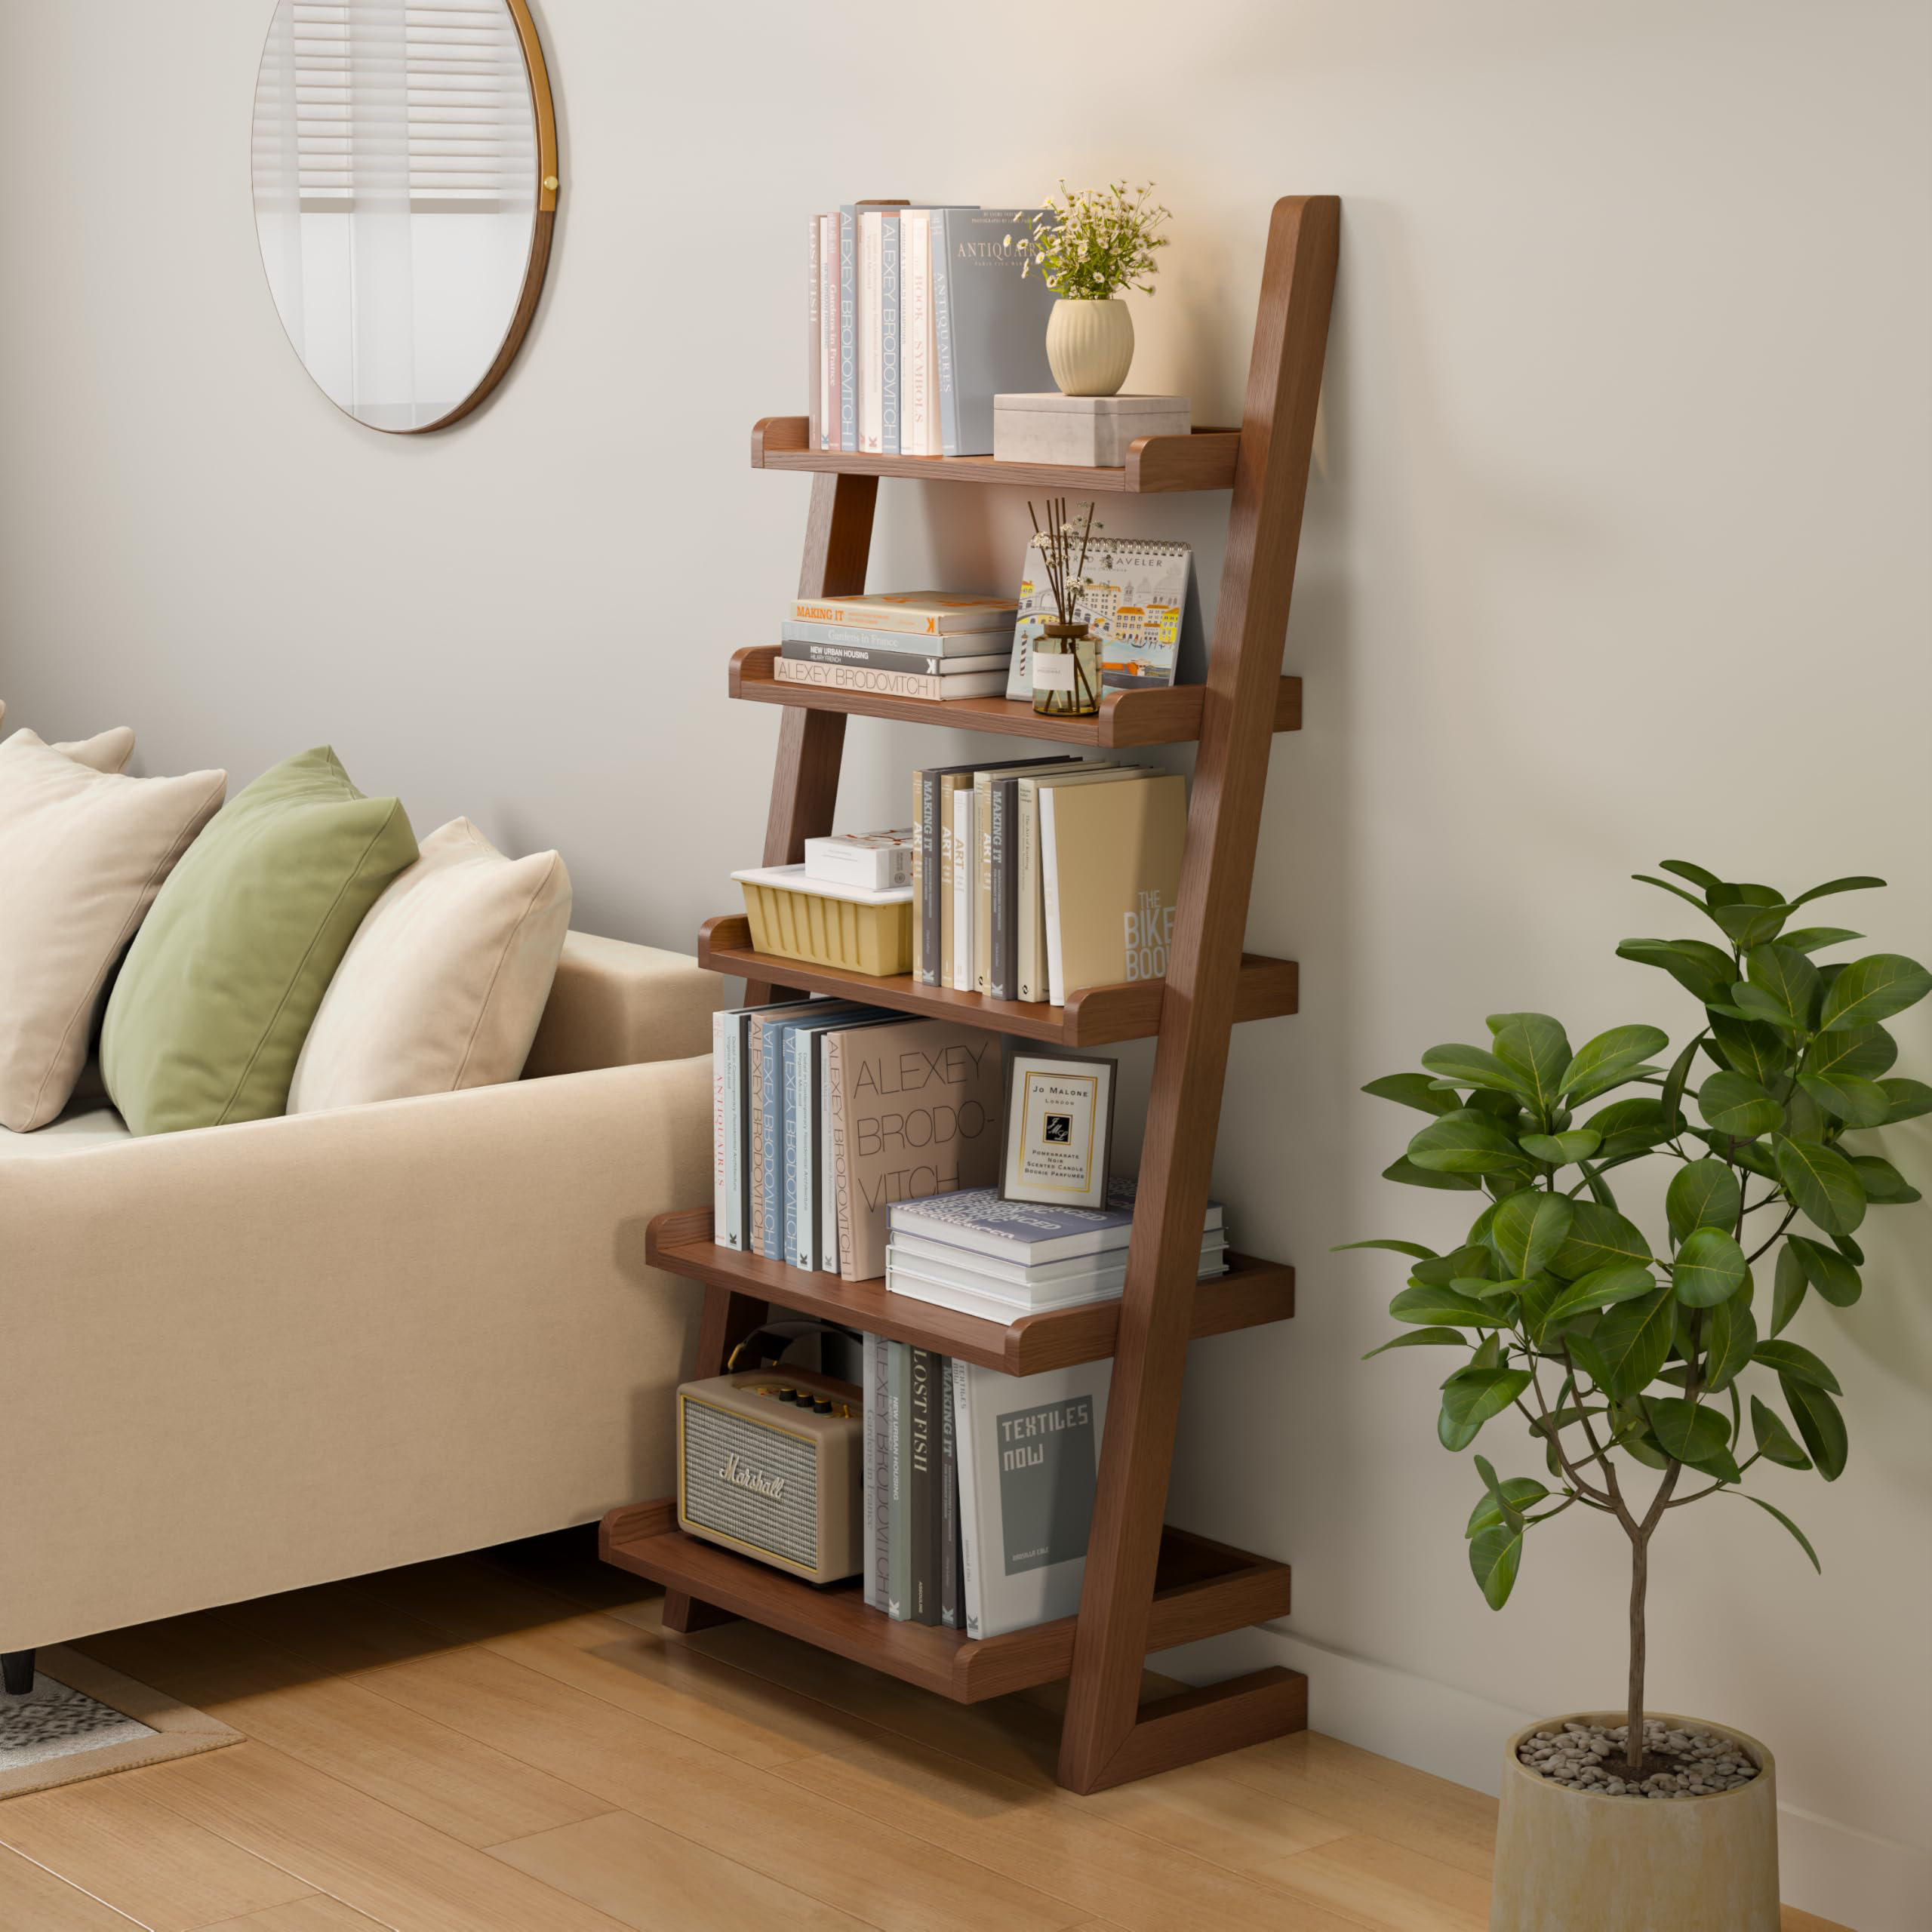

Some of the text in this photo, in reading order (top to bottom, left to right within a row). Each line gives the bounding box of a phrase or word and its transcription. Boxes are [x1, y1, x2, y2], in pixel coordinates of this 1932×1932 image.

[958, 242, 1039, 261] ANTIQUAIR
[841, 211, 853, 435] ALEXEY BRODOVITCH
[883, 223, 897, 438] ALEXEY BRODOVITCH
[937, 272, 951, 393] ANTIQUAIRES
[796, 605, 833, 620] MAKING
[834, 609, 845, 622] IT
[810, 645, 869, 660] NEW URBAN HOUSING
[810, 654, 825, 663] HILARY
[828, 629, 899, 648] Gardens in France
[777, 661, 928, 697] ALEXEY BRODOVITCH
[923, 780, 933, 834] MAKING
[992, 790, 1002, 845] MAKING
[913, 820, 922, 854] ART
[923, 837, 933, 852] IT
[941, 826, 952, 860] ART
[954, 838, 965, 869] ART
[992, 848, 1002, 863] IT
[1138, 889, 1161, 909] THE
[1123, 905, 1178, 950] BIKE
[1125, 945, 1171, 983] BOO
[854, 1040, 989, 1100] ALEXEY
[716, 1075, 724, 1186] ANTIQUAIRES
[752, 1021, 763, 1241] ALEXEY BRODOVITCH
[857, 1100, 995, 1156] BRODO-
[829, 1039, 852, 1266] ALEXEY BRODOVITCH
[857, 1161, 961, 1213] VITCH
[943, 1365, 952, 1435] MAKING
[958, 1364, 967, 1410] TEXTILES
[913, 1349, 928, 1473] LOST FISH
[1001, 1404, 1088, 1442] TEXTILES
[866, 1409, 875, 1530] Gardens in France
[943, 1438, 952, 1457] IT
[719, 1453, 784, 1499] Marshall
[876, 1432, 888, 1593] BRODOVITCH
